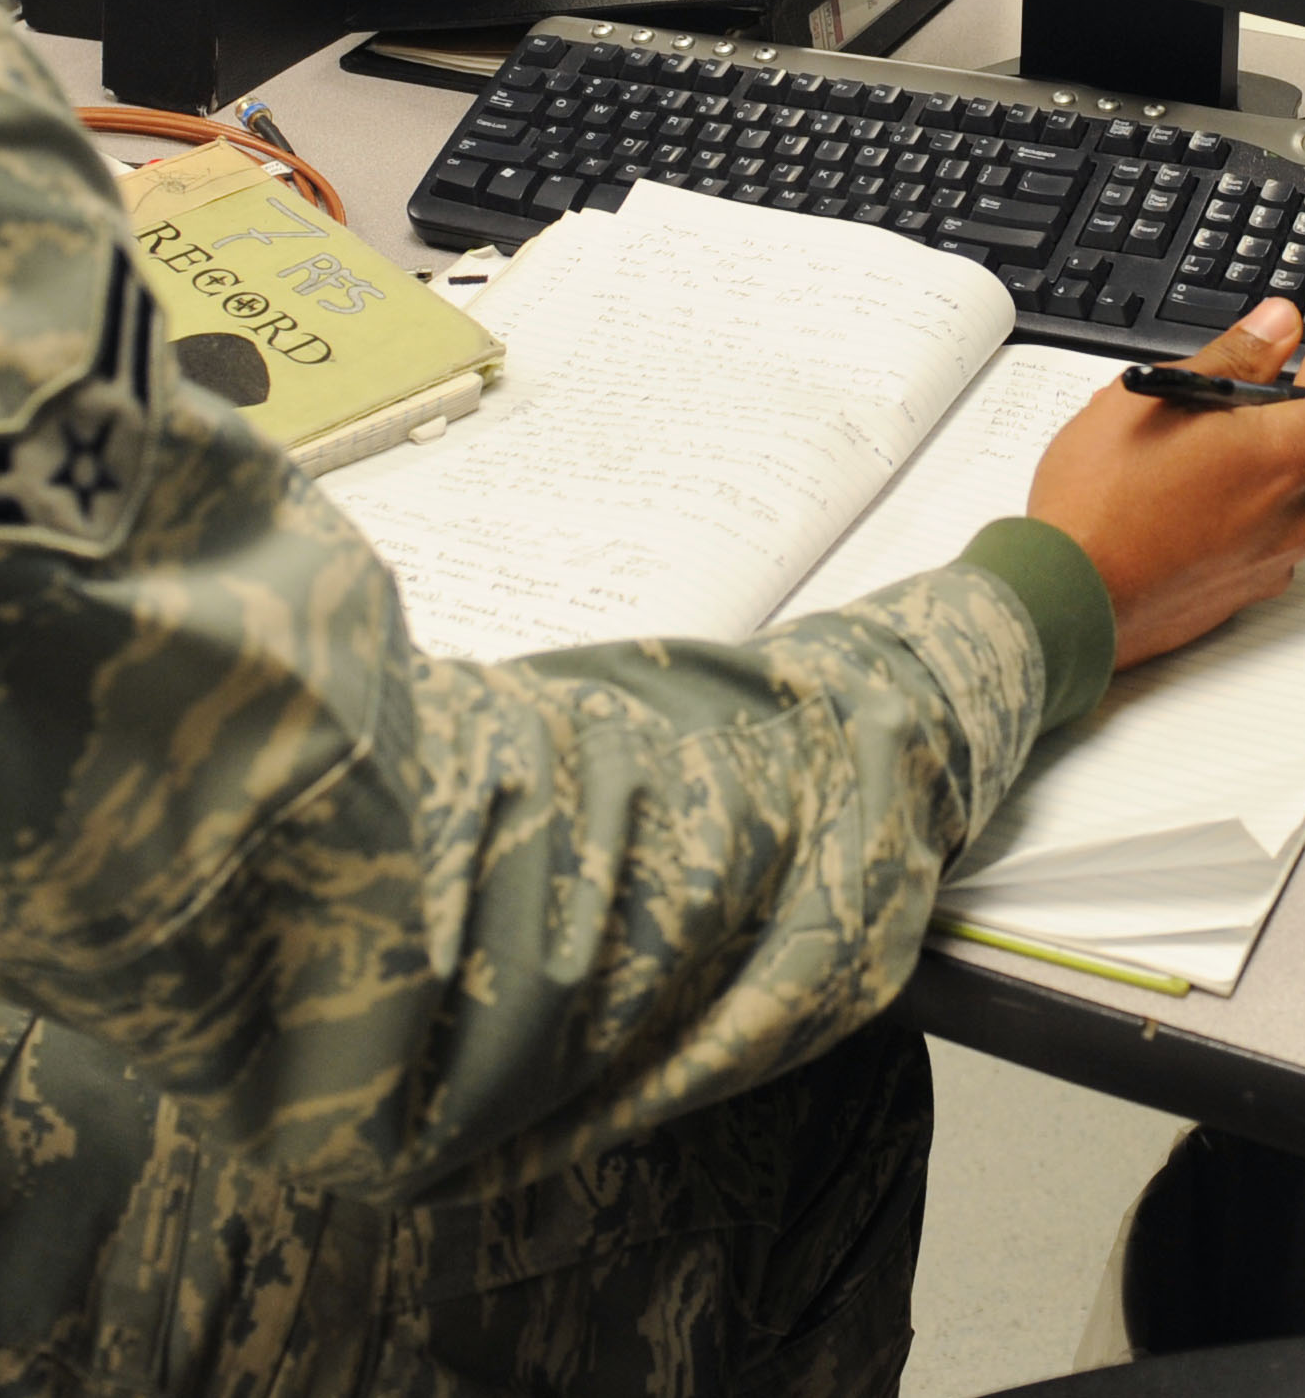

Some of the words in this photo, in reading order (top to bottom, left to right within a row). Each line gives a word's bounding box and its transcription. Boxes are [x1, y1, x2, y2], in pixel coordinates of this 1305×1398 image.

[212, 196, 329, 250] 7
[133, 220, 333, 364] RECORD
[276, 252, 387, 315] RFS
